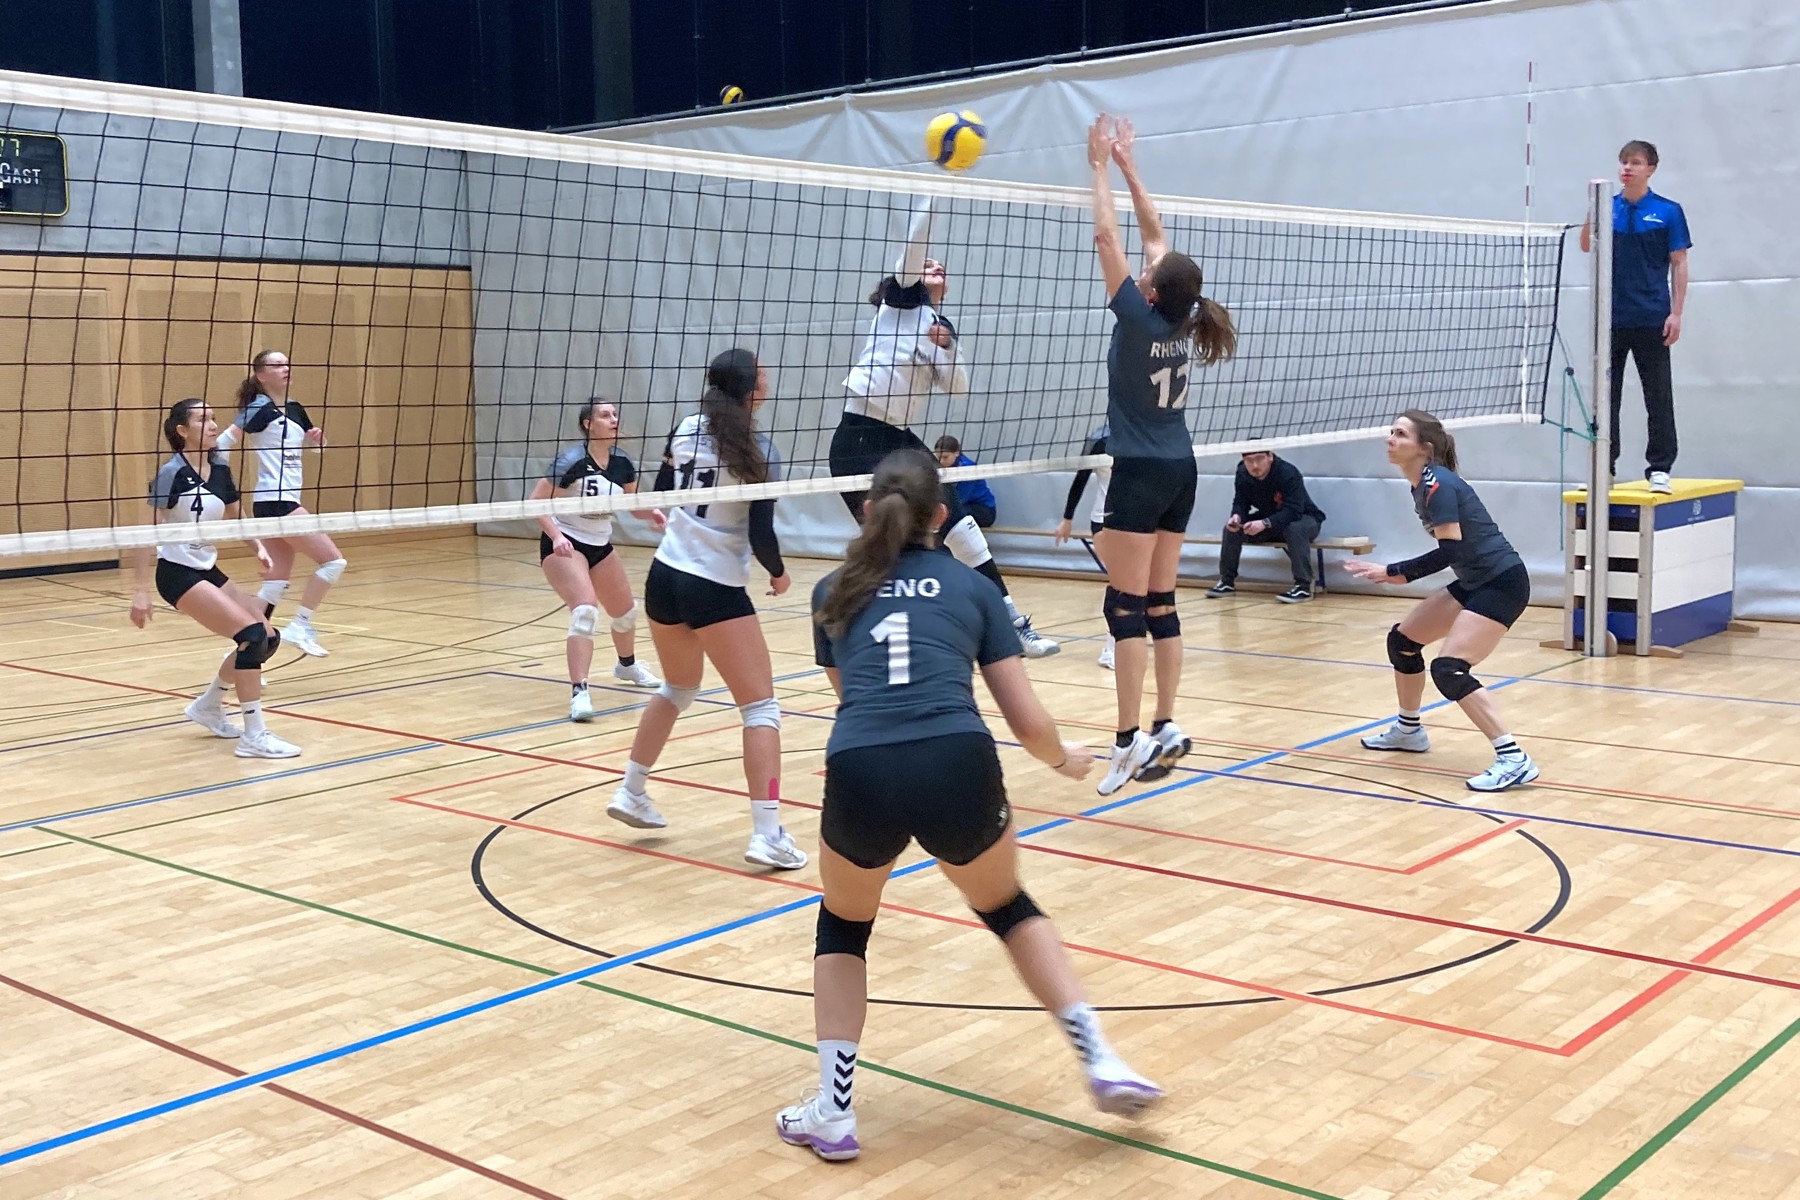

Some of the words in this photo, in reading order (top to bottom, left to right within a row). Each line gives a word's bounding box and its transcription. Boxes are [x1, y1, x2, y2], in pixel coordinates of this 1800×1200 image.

[586, 479, 599, 497] 5
[190, 493, 204, 516] 4
[876, 577, 941, 598] ENO
[869, 611, 910, 685] 1
